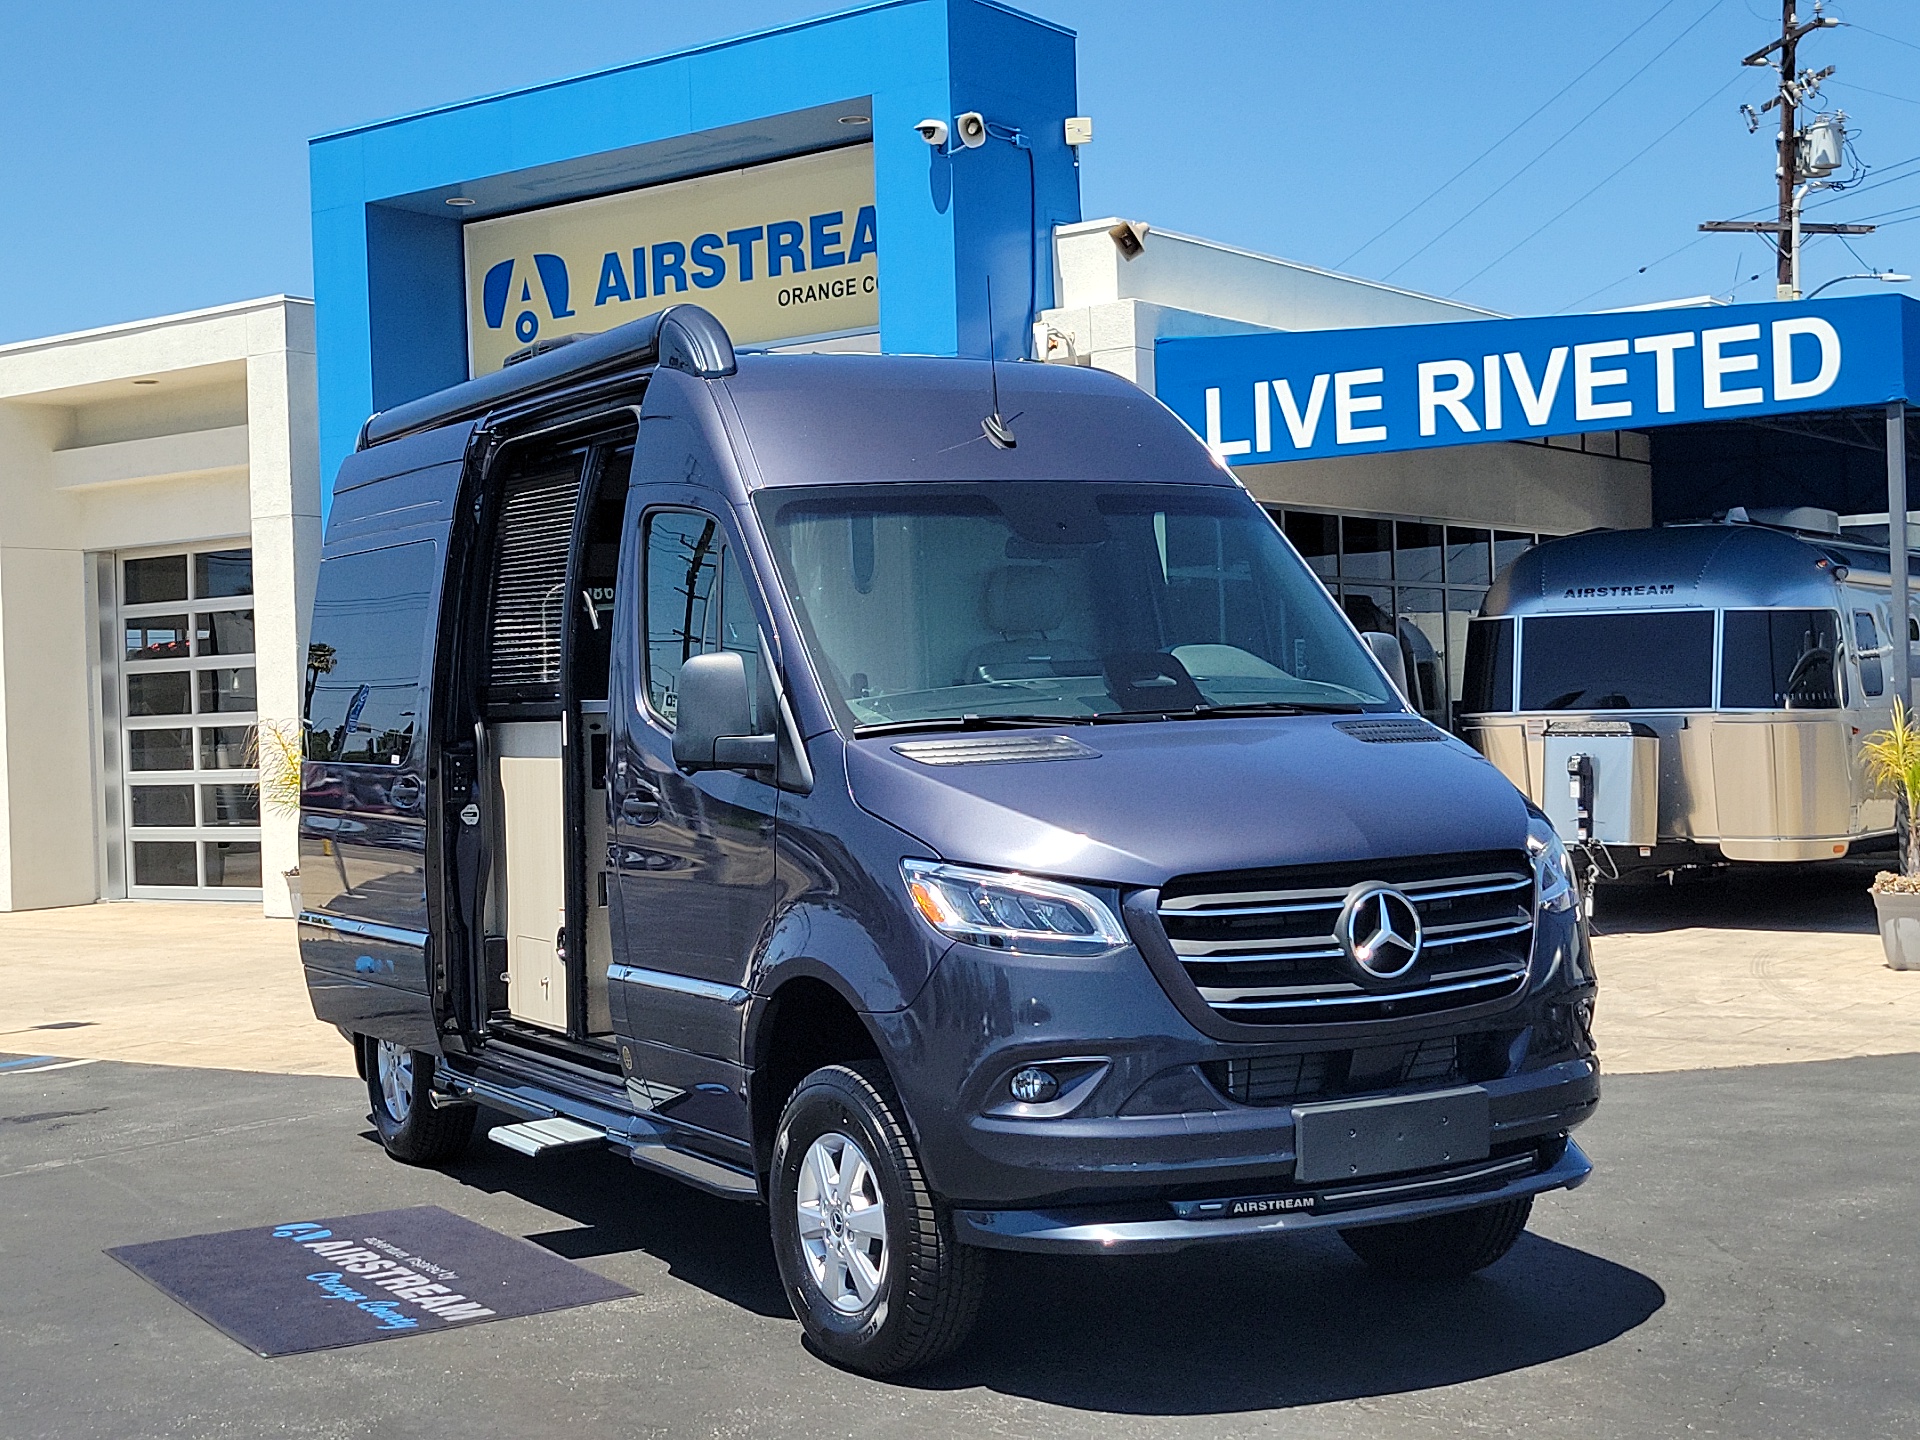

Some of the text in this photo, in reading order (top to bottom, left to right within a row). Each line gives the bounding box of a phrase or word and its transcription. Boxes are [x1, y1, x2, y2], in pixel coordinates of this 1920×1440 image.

[594, 204, 877, 307] AIRSTREA
[778, 275, 879, 307] ORANGE C
[1204, 316, 1842, 459] LIVE RIVETED
[1563, 584, 1675, 599] AIRSTREAM
[1233, 1198, 1314, 1213] AIRSTREAM
[302, 1240, 496, 1321] AIRSTREAM
[306, 1271, 419, 1329] Orange County
